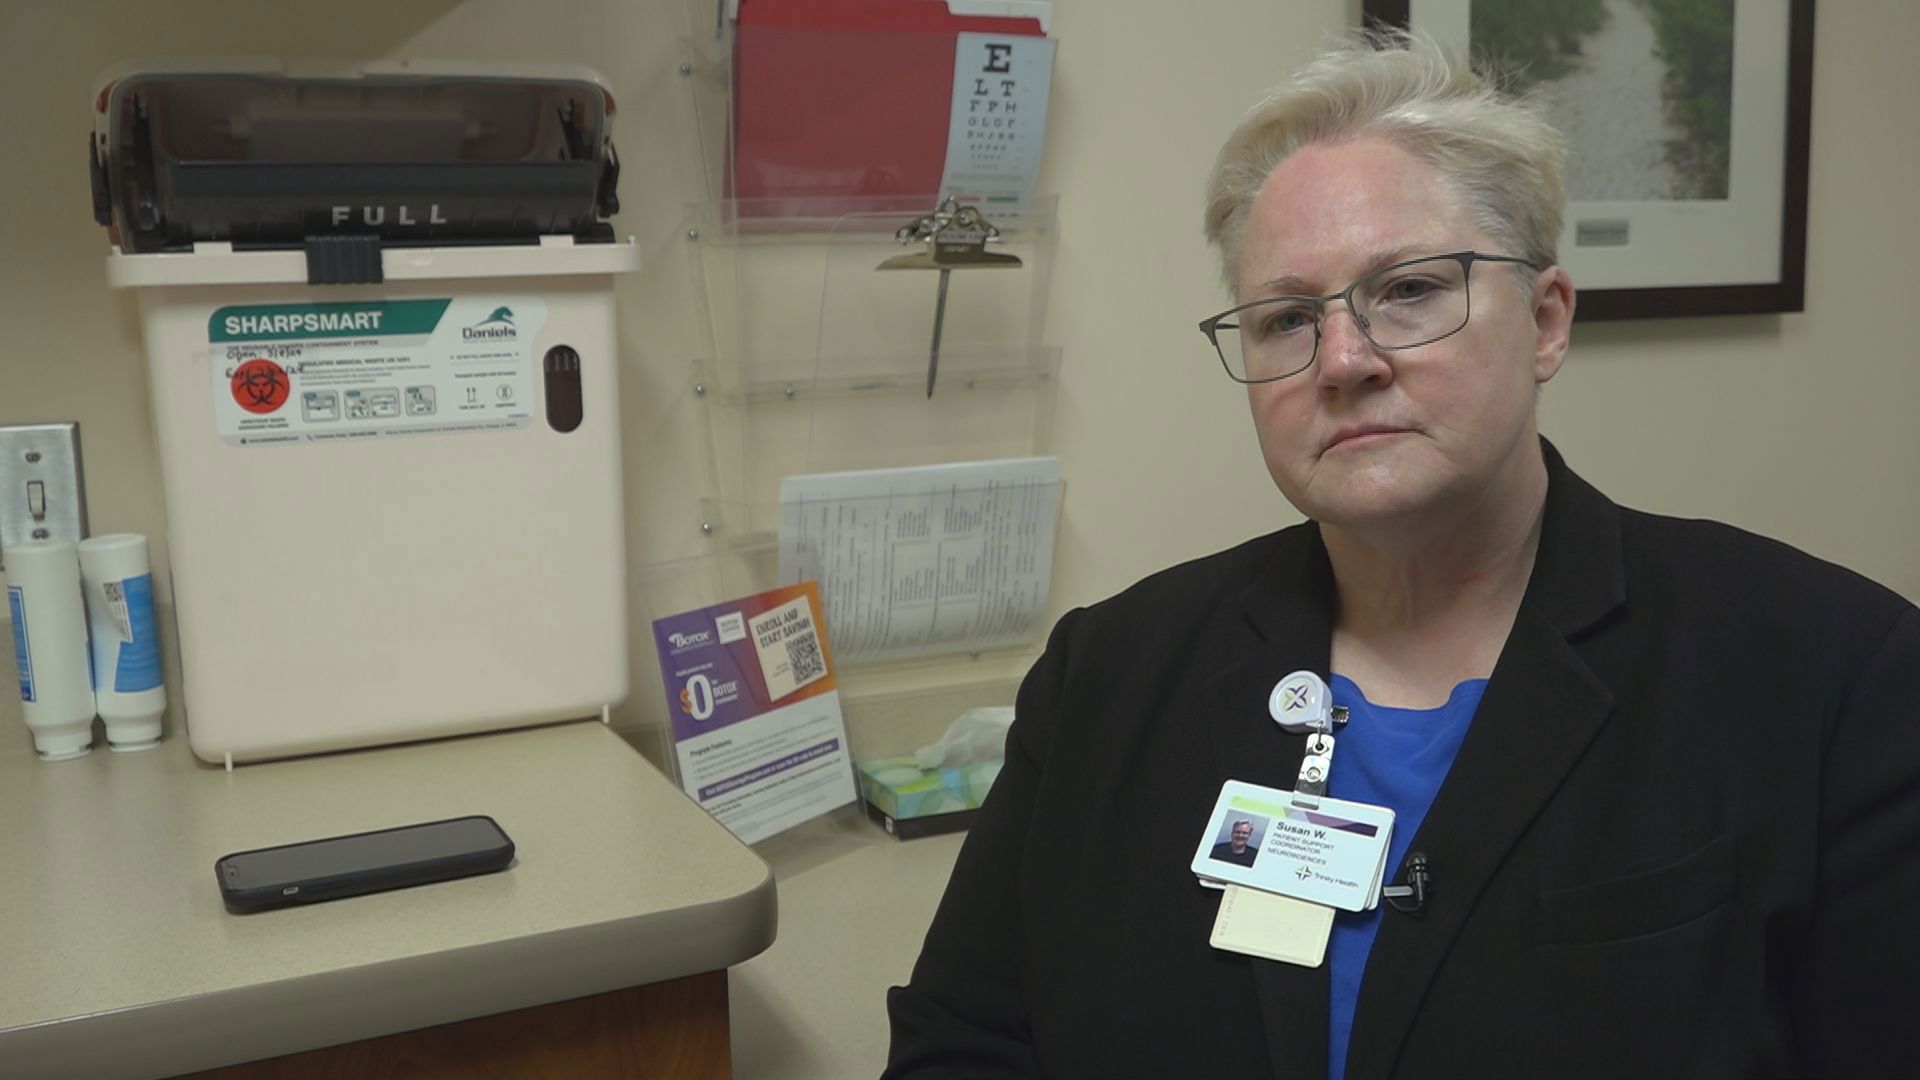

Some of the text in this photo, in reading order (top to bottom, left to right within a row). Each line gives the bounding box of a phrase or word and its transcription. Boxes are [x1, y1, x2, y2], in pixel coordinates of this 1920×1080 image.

[982, 43, 1012, 73] E
[332, 204, 447, 226] FULL
[225, 311, 382, 335] SHARPSMART
[462, 326, 516, 340] Daniels
[669, 631, 710, 648] BOTOX
[1276, 821, 1327, 840] Susan W.
[1270, 839, 1321, 854] COORDINATOR
[1272, 832, 1335, 851] PATIENT SUPPORT
[1315, 872, 1359, 889] Trinity Health
